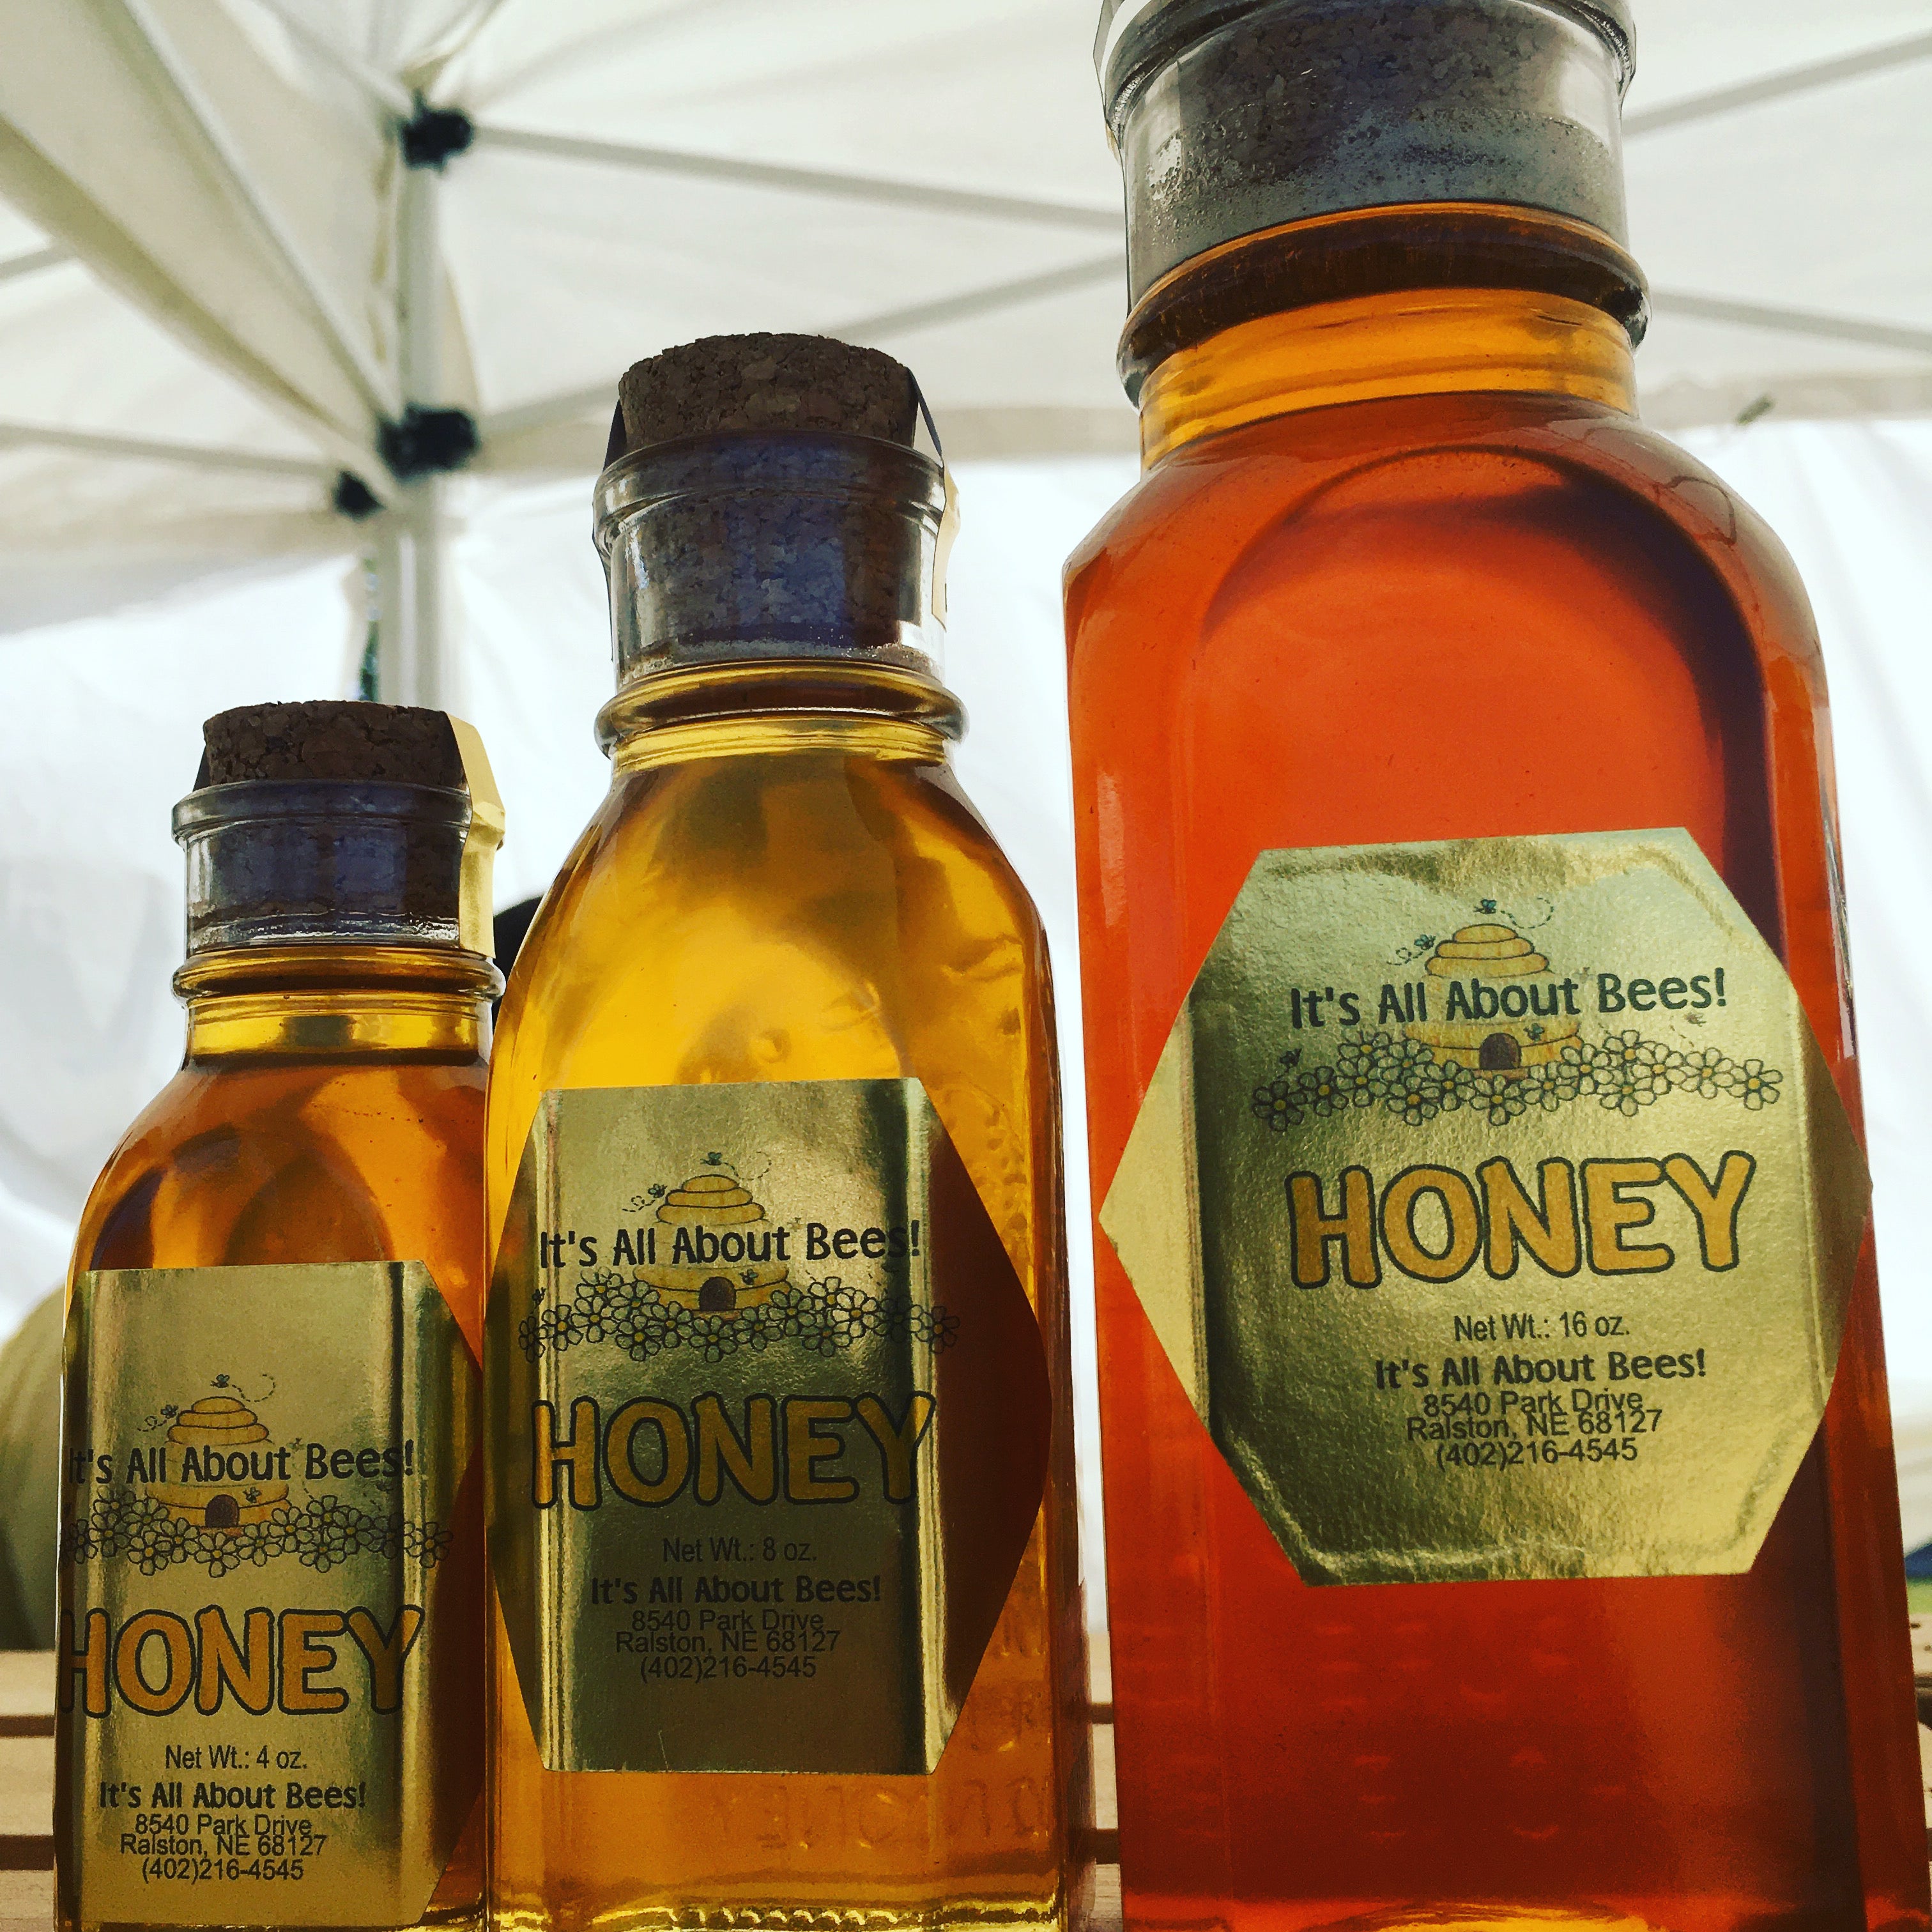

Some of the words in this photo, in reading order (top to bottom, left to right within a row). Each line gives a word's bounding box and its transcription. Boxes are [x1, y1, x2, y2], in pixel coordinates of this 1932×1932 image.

[1291, 988, 1360, 1029] It's
[1378, 983, 1427, 1023] All
[1446, 977, 1581, 1020] About
[1597, 969, 1726, 1014] Bees!
[1286, 1151, 1756, 1289] HONEY
[539, 1231, 597, 1268] It's
[613, 1228, 656, 1266] All
[673, 1227, 791, 1264] About
[806, 1220, 919, 1260] Bees!
[1455, 1315, 1498, 1342] Net
[1503, 1314, 1550, 1341] Wt.:
[1559, 1313, 1588, 1339] 16
[1595, 1315, 1629, 1337] oz.
[1376, 1360, 1427, 1389] It's
[1441, 1358, 1480, 1386] All
[1493, 1354, 1594, 1383] About
[1609, 1349, 1706, 1380] Bees!
[1423, 1392, 1490, 1416] 8540
[1500, 1390, 1565, 1413] Park
[1573, 1387, 1643, 1411] Drive
[1408, 1414, 1517, 1442] Ralston,
[1528, 1413, 1567, 1438] NE
[1577, 1408, 1662, 1434] 68127
[70, 1448, 112, 1483] It's
[128, 1448, 166, 1483] All
[181, 1446, 292, 1483] About
[306, 1439, 414, 1480] Bees!
[532, 1390, 935, 1510] HONEY
[1436, 1438, 1637, 1470] (402)216-4545
[663, 1538, 703, 1563] Net
[707, 1538, 753, 1562] Wt.:
[762, 1538, 776, 1561] 8
[783, 1541, 817, 1561] oz.
[591, 1578, 636, 1604] It's
[648, 1578, 682, 1602] All
[694, 1577, 785, 1602] About
[795, 1576, 881, 1602] Bees!
[631, 1610, 690, 1632] 8540
[698, 1610, 756, 1631] Park
[762, 1609, 824, 1630] Drive
[615, 1631, 712, 1654] Ralston,
[721, 1631, 757, 1652] NE
[766, 1630, 840, 1652] 68127
[60, 1604, 425, 1718] HONEY
[640, 1655, 816, 1683] (402)216-4545
[165, 1745, 202, 1769] Net
[208, 1745, 250, 1769] Wt.:
[256, 1746, 268, 1768] 4
[276, 1750, 307, 1769] oz.
[99, 1784, 142, 1809] It's
[151, 1784, 183, 1809] All
[192, 1783, 276, 1809] About
[286, 1782, 366, 1809] Bees!
[135, 1815, 190, 1834] 8540
[197, 1815, 250, 1836] Park
[254, 1815, 312, 1836] Drive
[120, 1834, 209, 1857] Ralston,
[217, 1836, 250, 1855] NE
[257, 1835, 327, 1855] 68127
[142, 1859, 304, 1883] (402)216-4545
